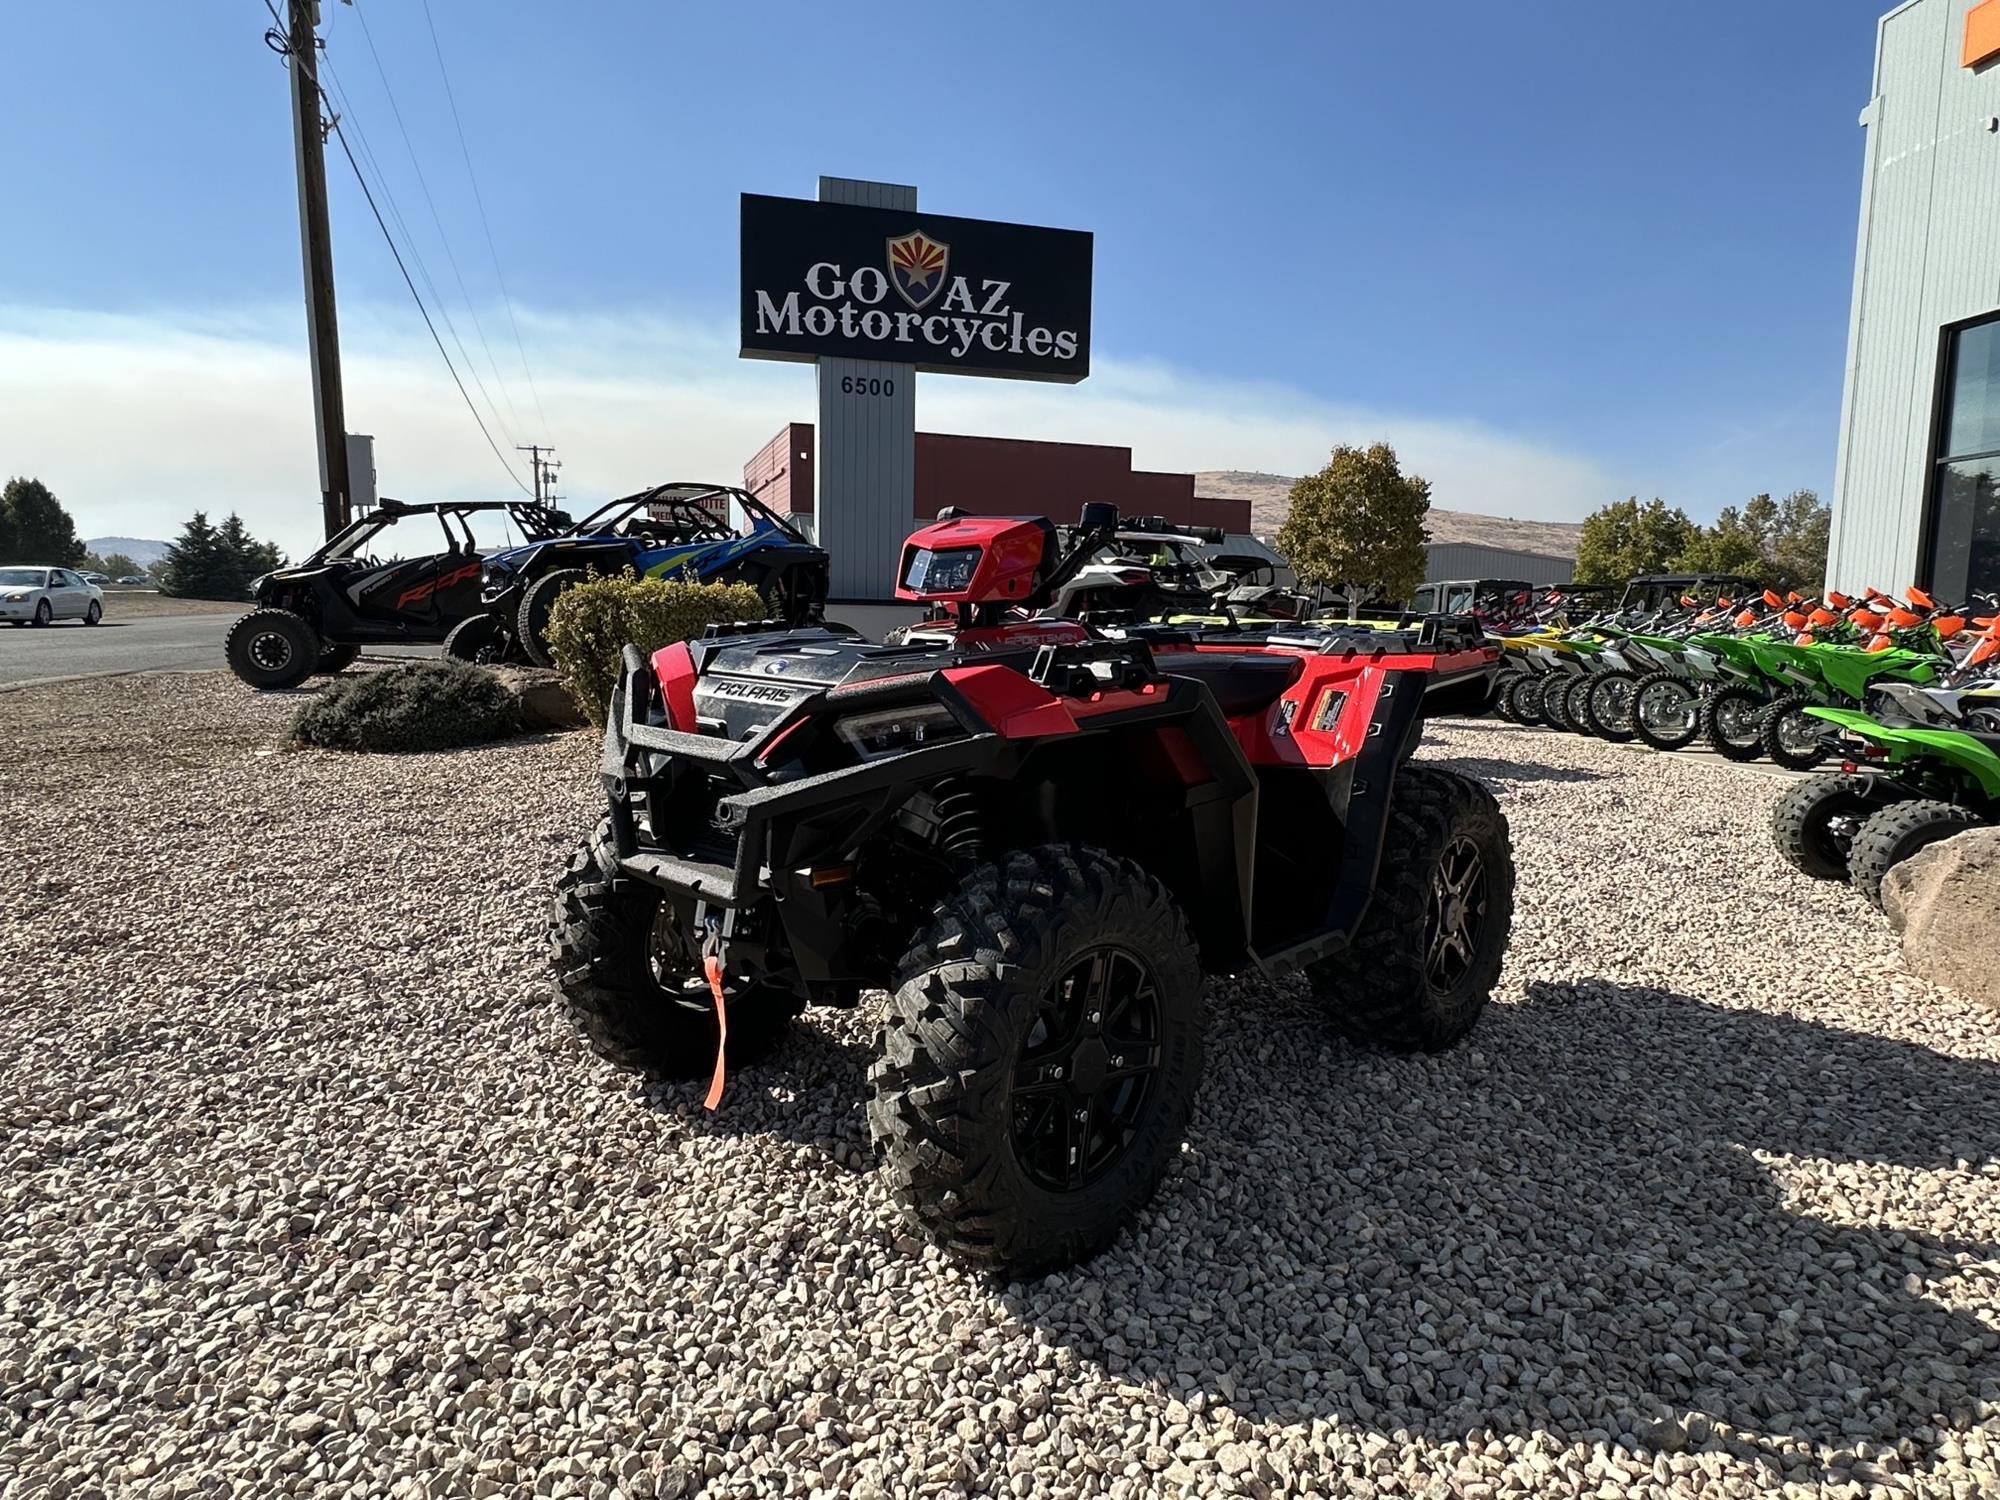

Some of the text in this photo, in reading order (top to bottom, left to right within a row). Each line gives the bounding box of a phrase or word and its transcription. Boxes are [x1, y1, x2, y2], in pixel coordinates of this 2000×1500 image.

[804, 262, 1011, 317] GO AZ
[755, 289, 1078, 359] Motorcycles
[841, 376, 895, 398] 6500
[395, 561, 481, 610] RZR
[713, 682, 793, 702] POLARIS
